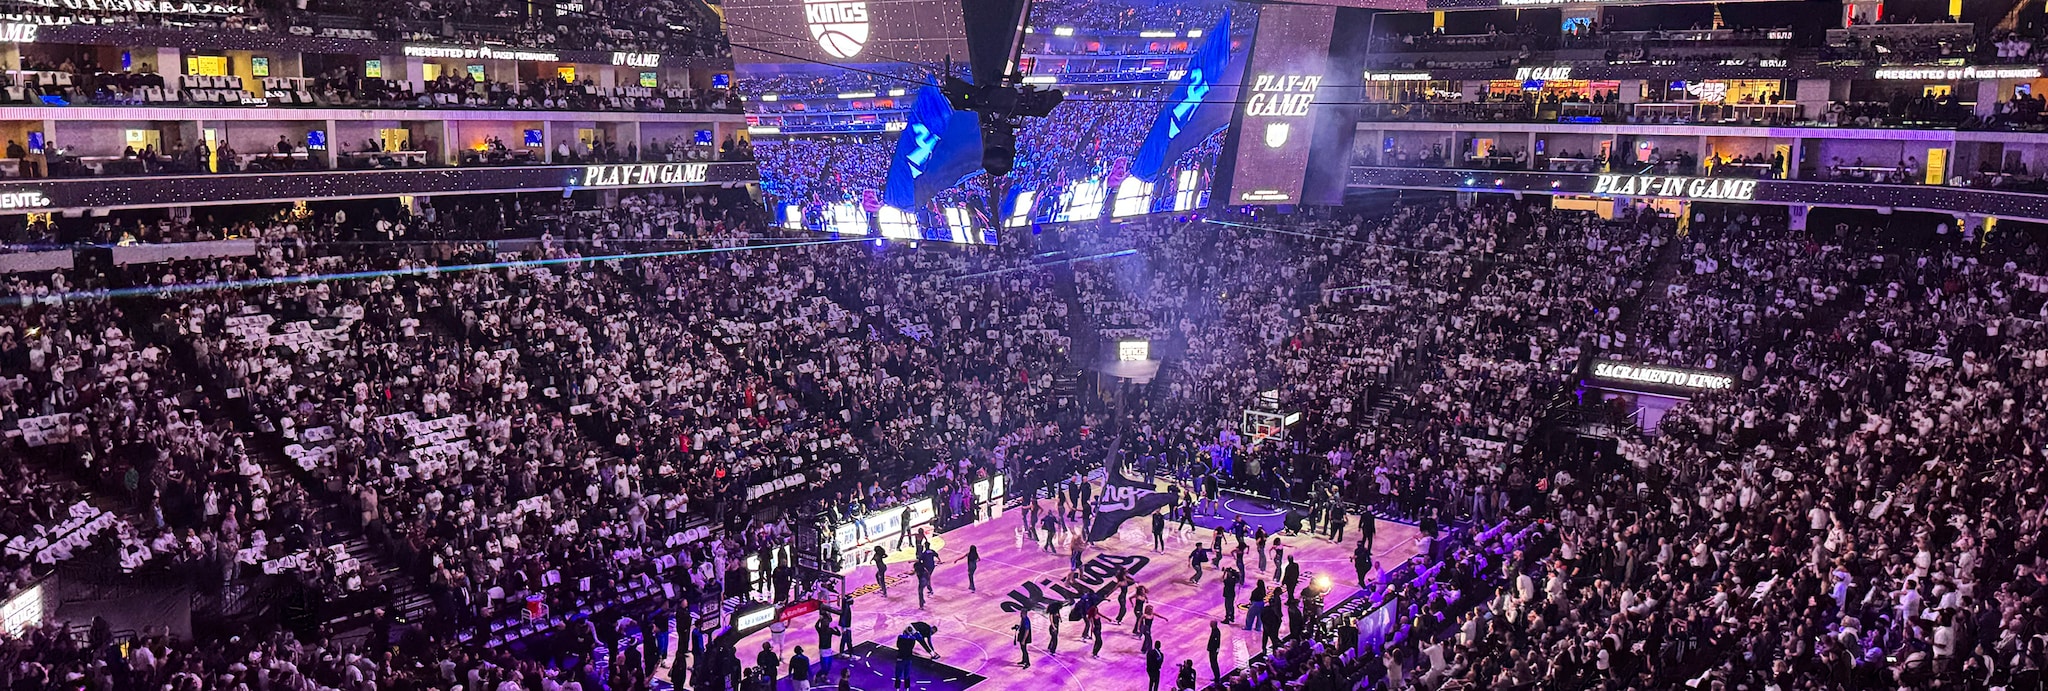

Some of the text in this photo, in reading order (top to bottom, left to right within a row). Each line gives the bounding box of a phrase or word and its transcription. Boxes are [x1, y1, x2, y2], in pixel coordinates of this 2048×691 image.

[805, 2, 868, 24] KINGS
[404, 47, 462, 58] PRESENTED
[465, 50, 478, 58] BY
[612, 52, 660, 67] IN GAME
[1515, 67, 1571, 80] IN GAME
[1875, 69, 1945, 80] PRESENTED
[1947, 70, 1962, 79] BY
[1253, 75, 1321, 92] PLAY-IN
[1246, 93, 1315, 116] GAME
[583, 163, 708, 186] PLAY-IN GAME
[1593, 175, 1757, 200] PLAY-IN GAME
[1594, 363, 1732, 390] SACRAMENTO KINGS
